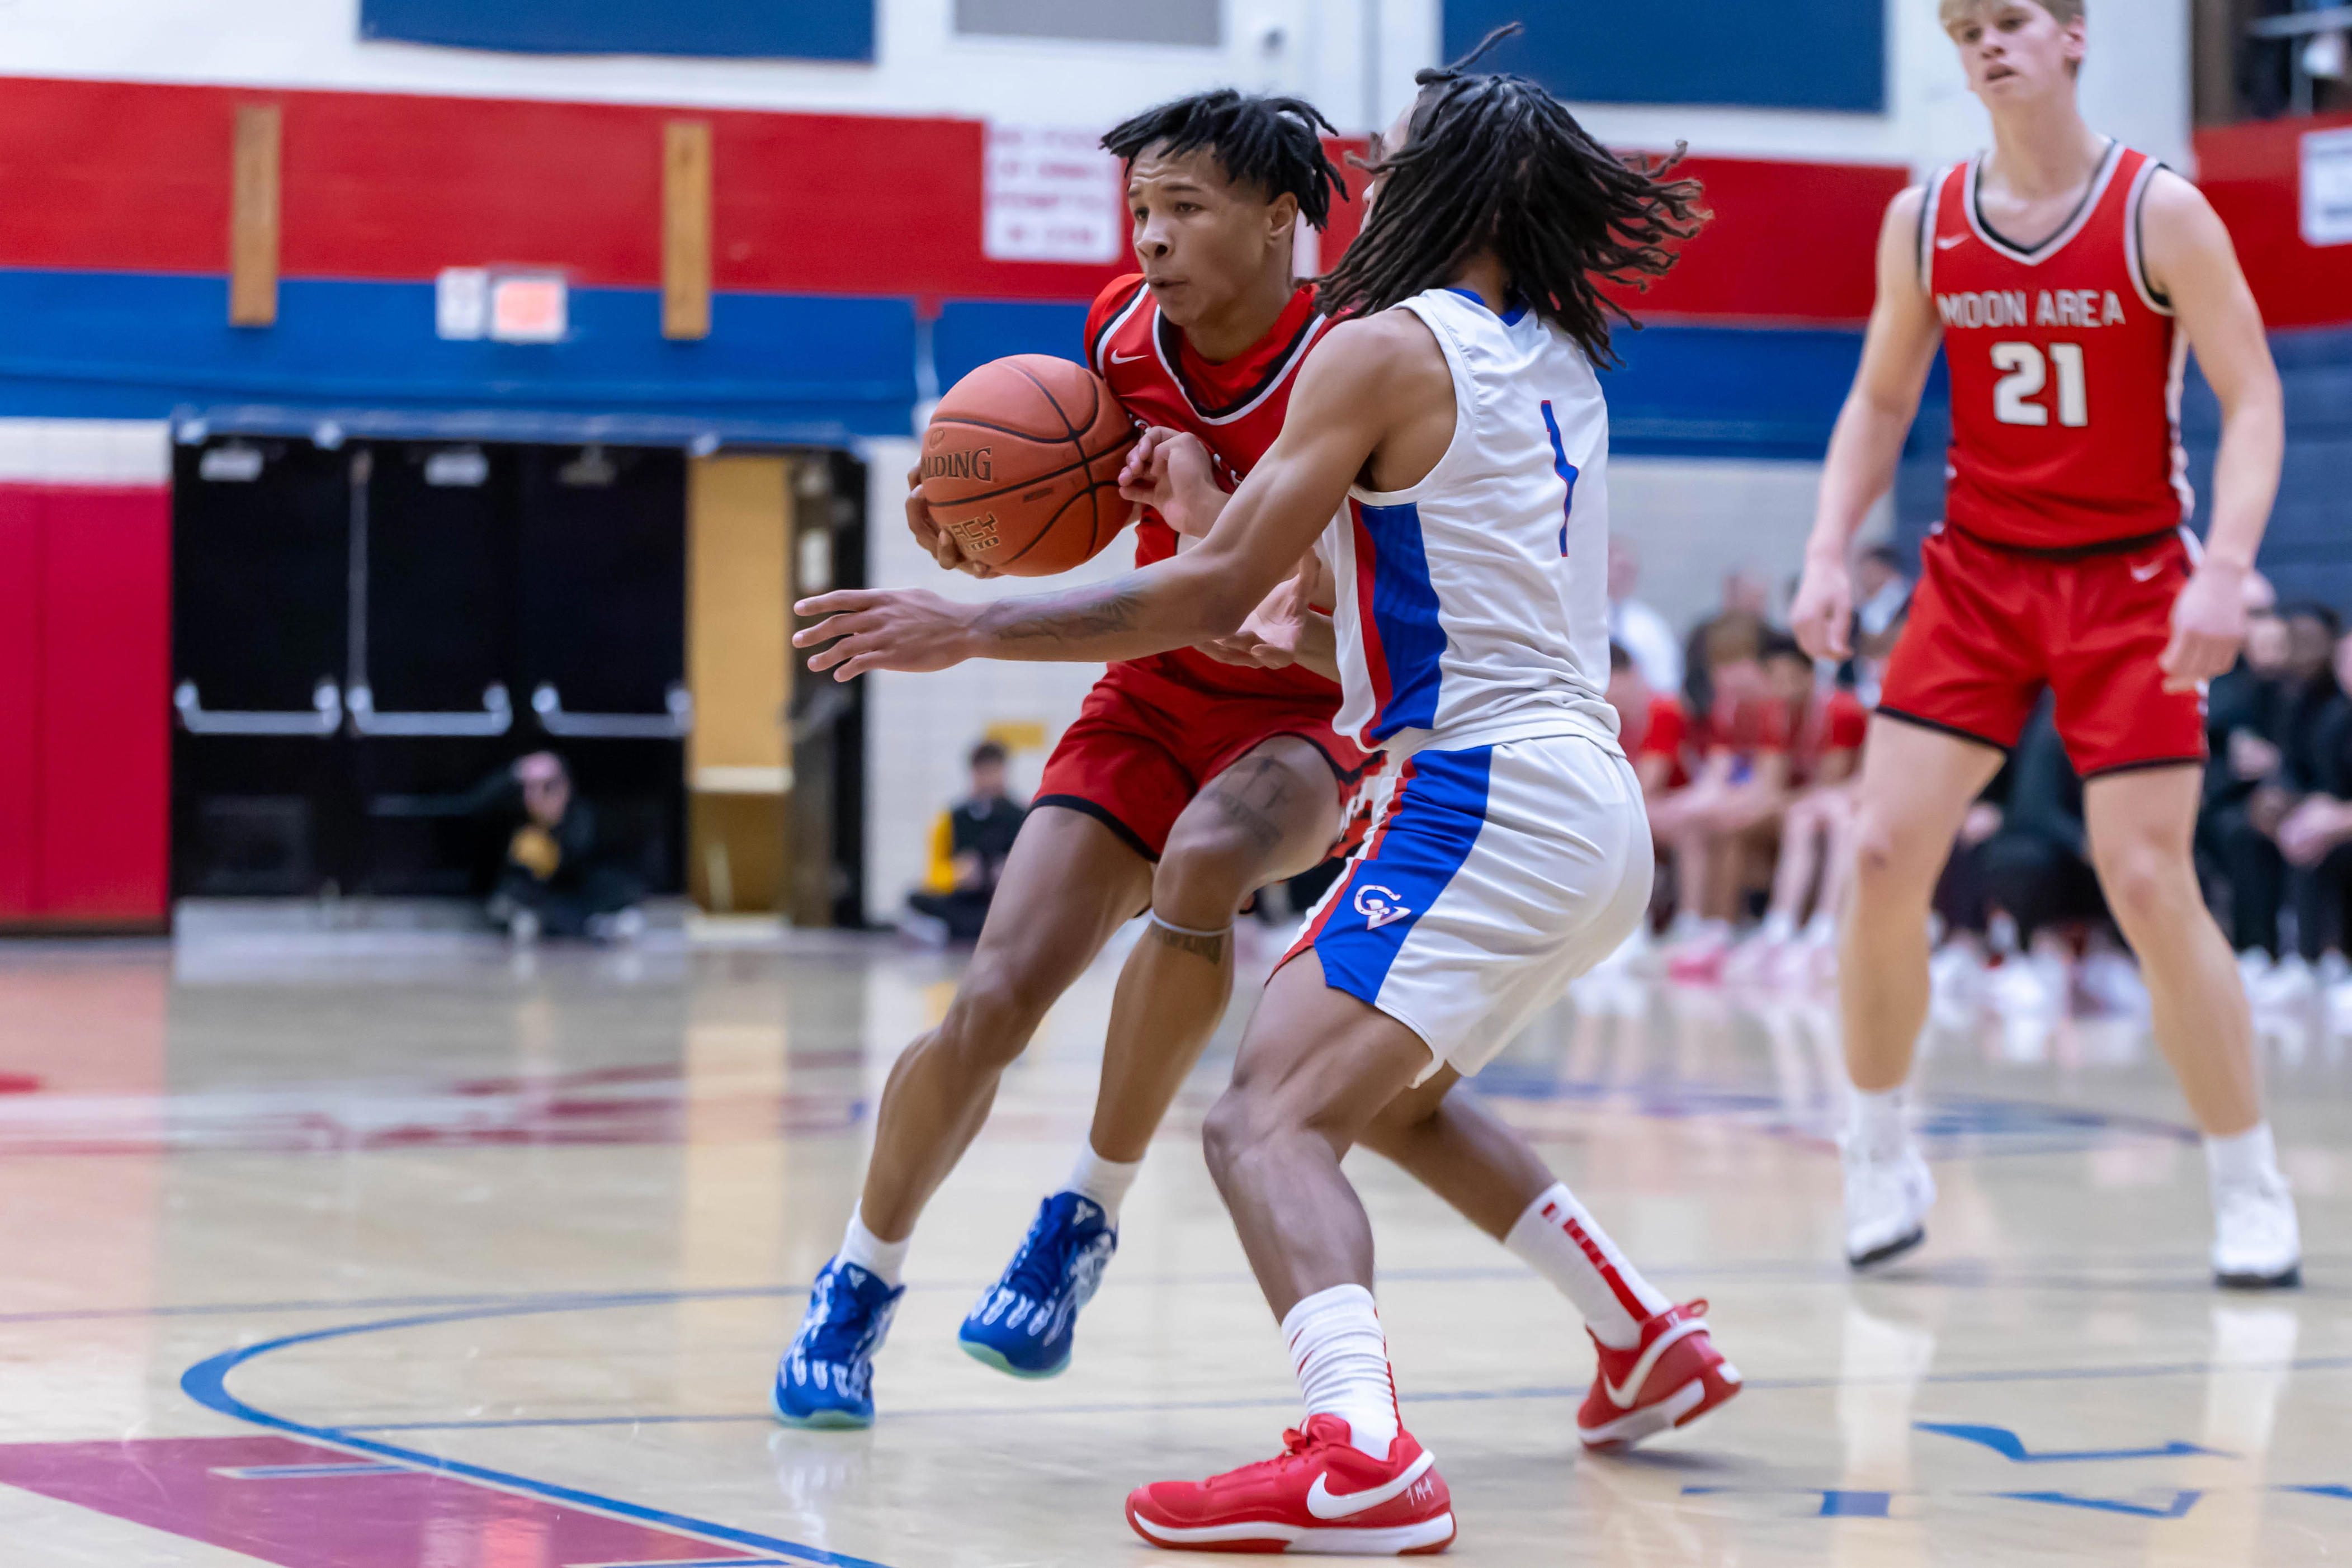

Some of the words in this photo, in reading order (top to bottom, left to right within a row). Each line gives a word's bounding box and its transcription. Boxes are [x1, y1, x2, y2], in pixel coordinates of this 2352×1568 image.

[1937, 290, 2028, 328] MOON
[2036, 290, 2126, 328] AREA
[1990, 341, 2088, 427] 21
[922, 447, 991, 481] ALDING
[1541, 400, 1579, 557] 1
